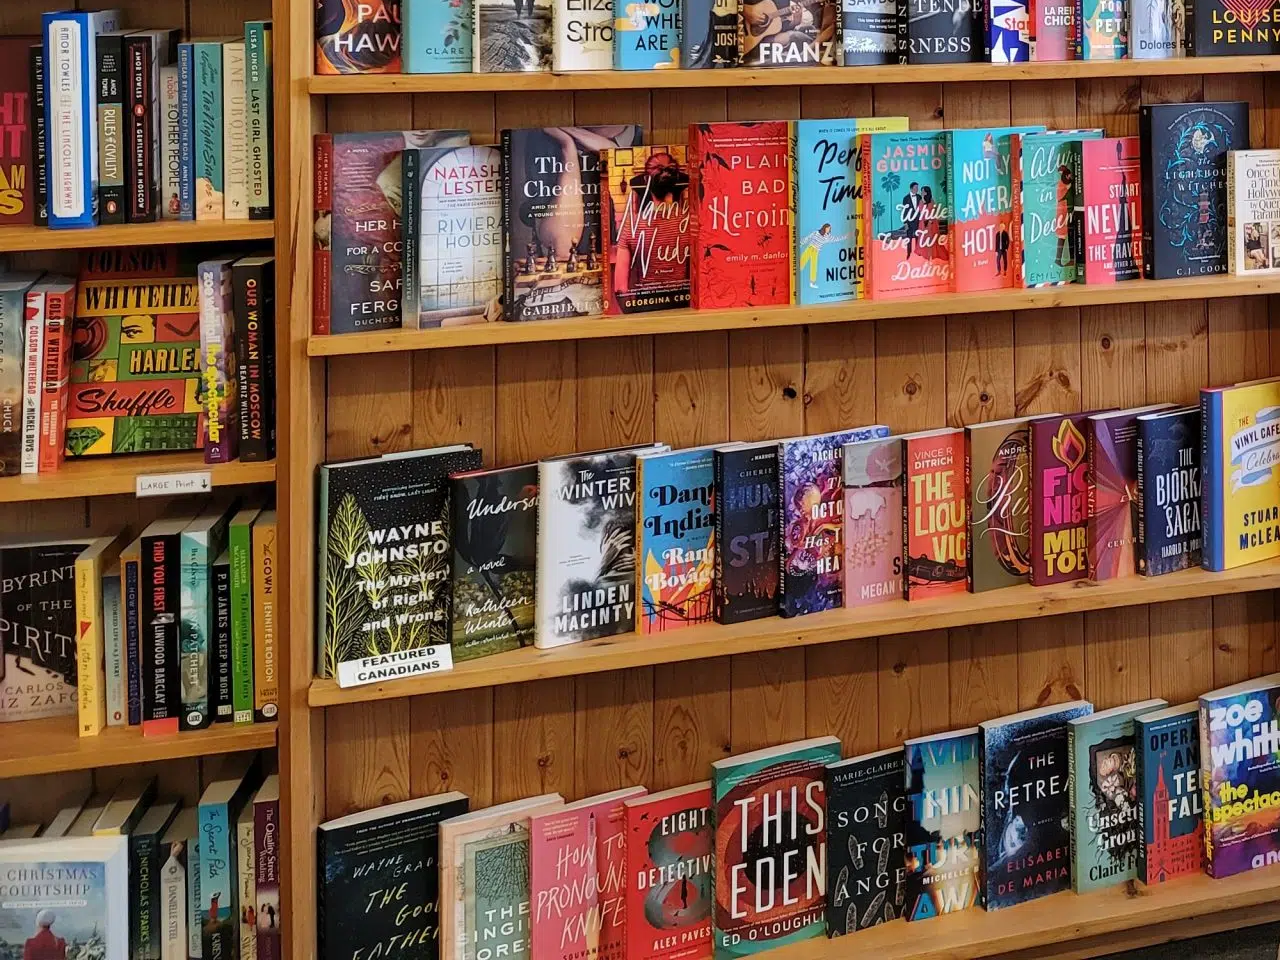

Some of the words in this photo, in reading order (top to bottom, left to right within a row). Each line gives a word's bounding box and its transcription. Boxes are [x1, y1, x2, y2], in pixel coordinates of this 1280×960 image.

[251, 52, 259, 82] UNGER
[251, 89, 260, 113] LAST
[251, 116, 260, 138] GIRL
[252, 141, 262, 196] GHOSTED
[962, 160, 990, 184] NOT
[1246, 168, 1270, 179] Once
[742, 181, 786, 195] BAD
[1109, 183, 1140, 199] STUART
[962, 224, 995, 257] HOT
[625, 295, 671, 308] GEORGINA
[75, 388, 177, 416] Shuffle
[1238, 416, 1250, 428] THE
[1234, 429, 1259, 451] VINYL
[1260, 423, 1280, 440] CAFE
[914, 456, 953, 470] DITRICH
[140, 481, 170, 491] LARGE
[175, 480, 196, 489] Print
[911, 470, 955, 505] THE
[368, 520, 444, 545] WAYNE
[355, 581, 385, 593] The
[390, 568, 449, 588] Mystery
[861, 580, 896, 600] MEGAN
[372, 599, 389, 612] of
[393, 589, 434, 607] Right
[465, 595, 532, 617] Kathleen
[562, 584, 630, 613] LINDEN
[361, 618, 391, 633] and
[395, 610, 444, 628] Wrong
[154, 625, 165, 668] LINWOOD
[362, 647, 437, 668] FEATURED
[357, 660, 440, 682] CANADIANS
[154, 671, 166, 705] BARCLAY
[1209, 699, 1264, 730] zoe
[1219, 781, 1249, 804] the
[733, 779, 825, 854] THIS
[836, 796, 905, 828] SONG
[6, 868, 98, 881] CHRISTMAS
[731, 842, 826, 920] EDEN
[1023, 867, 1068, 888] MARIA
